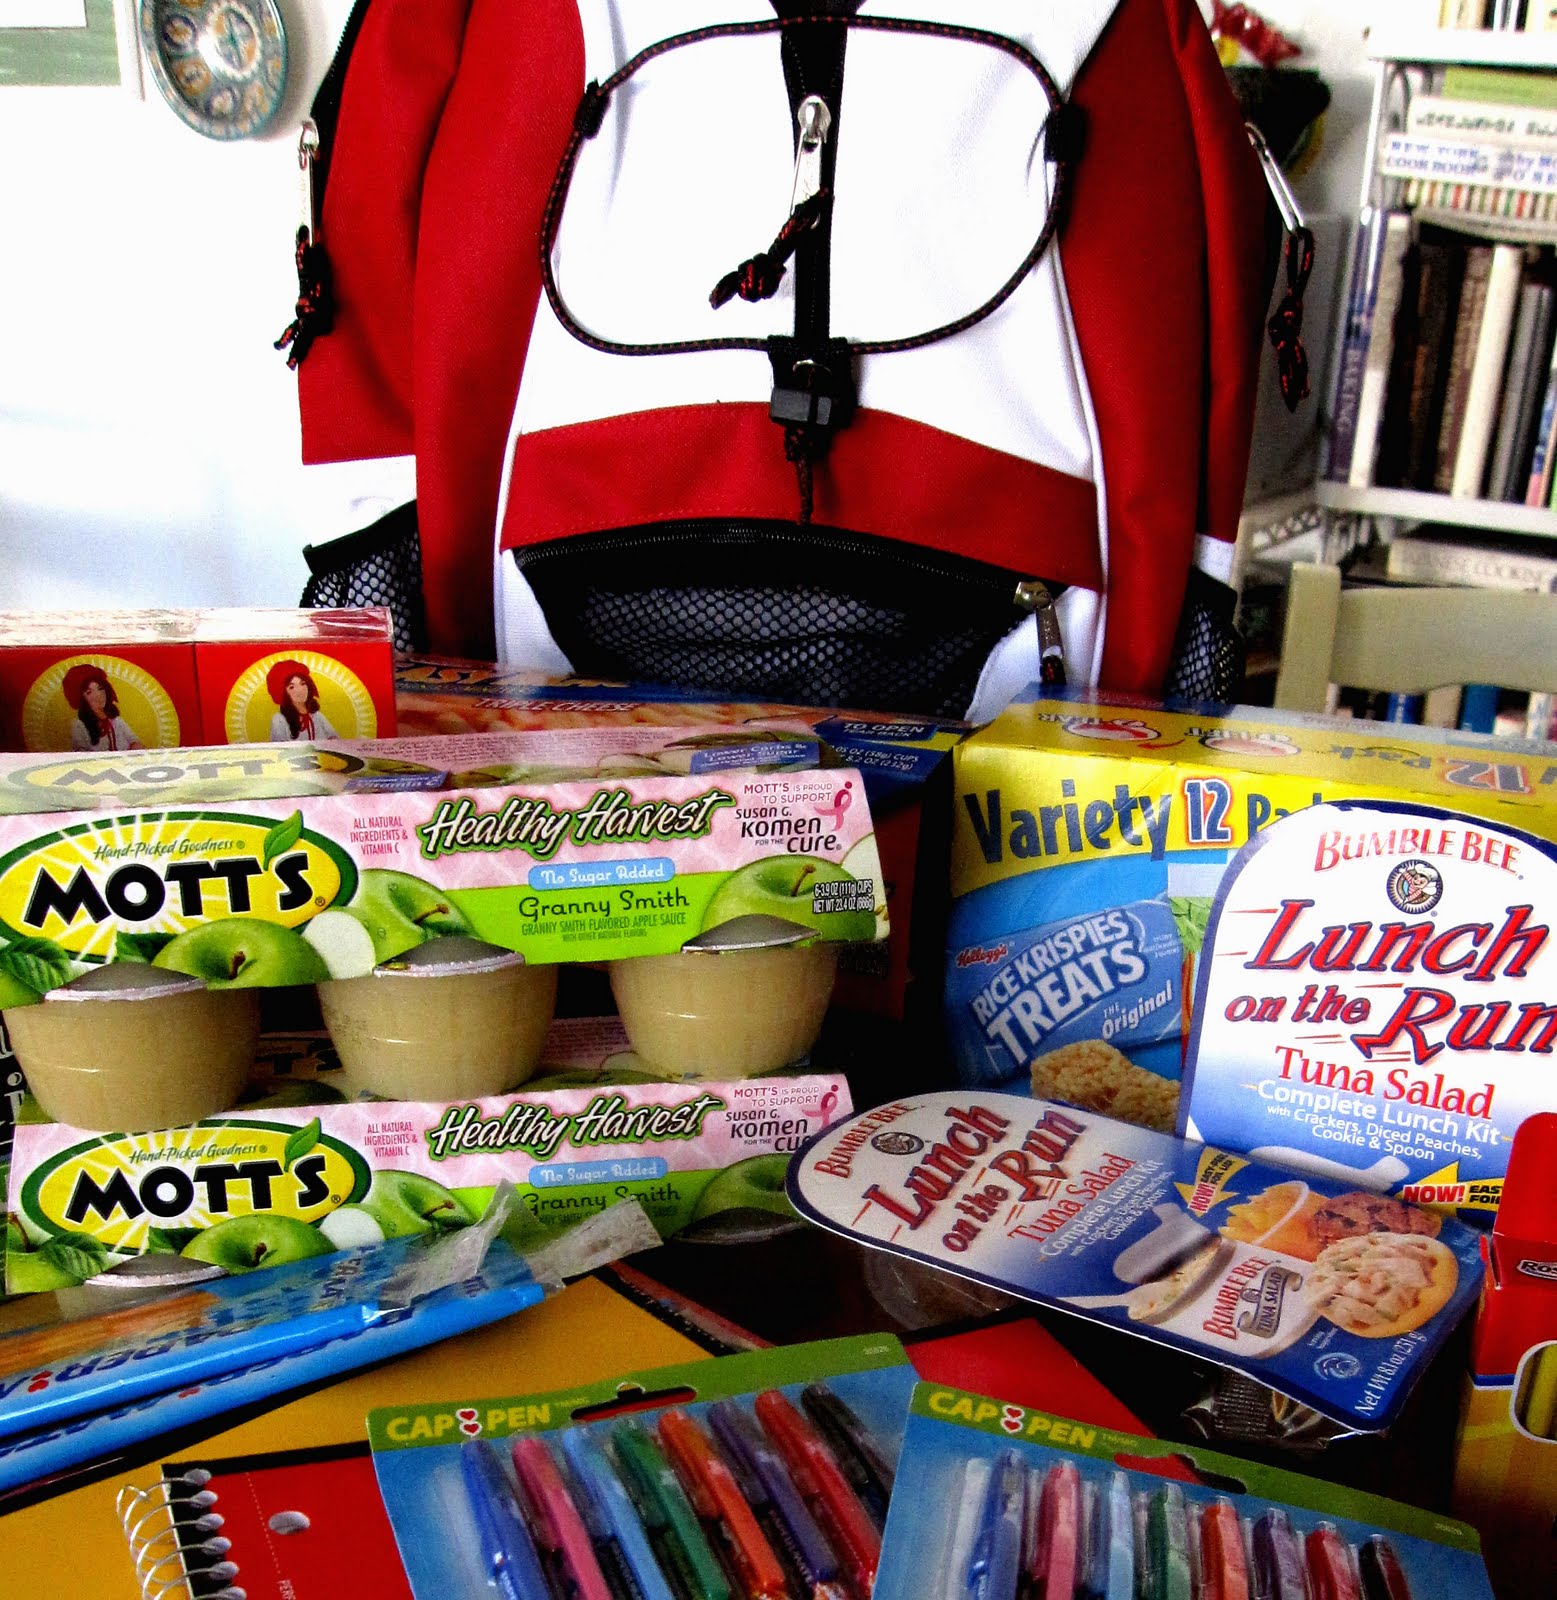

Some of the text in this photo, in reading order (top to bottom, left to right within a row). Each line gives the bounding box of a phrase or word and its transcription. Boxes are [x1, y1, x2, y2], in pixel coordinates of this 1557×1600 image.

[475, 699, 637, 712] TRIPLE CHEESE
[872, 724, 925, 733] OPEN
[864, 758, 880, 766] OZ
[893, 753, 920, 763] CUPS
[1446, 758, 1531, 793] 12
[744, 783, 832, 794] MOTT'S IS PROUD
[763, 792, 832, 804] TO SUPPORT
[353, 816, 403, 829] ALL NATURAL
[422, 790, 734, 856] Healthy Harvest
[782, 806, 792, 818] G.
[964, 779, 1171, 861] Variety
[1183, 778, 1232, 843] 12
[350, 829, 408, 843] INGREDIENTS &
[361, 842, 400, 855] VITAMIN C
[755, 838, 769, 846] FOR
[94, 838, 233, 860] Hand-Picked Goodness
[1314, 828, 1520, 876] BUMBLE BEE
[541, 863, 665, 885] No Sugar Added
[23, 853, 314, 928] MOTT'S
[830, 882, 839, 896] OZ
[857, 880, 872, 894] CUPS
[519, 887, 690, 922] Granny Smith
[813, 899, 825, 913] NET
[825, 899, 834, 911] WT
[848, 897, 856, 910] OZ
[522, 912, 686, 936] GRANNY SMITH FLAVORED APPLE SAUCE
[1243, 898, 1551, 982] Lunch
[955, 943, 1009, 967] Kellogg's
[972, 911, 1130, 1026] RICE KRISPIES
[985, 940, 1146, 1065] TREATS
[1101, 979, 1173, 1041] Original
[1103, 1001, 1120, 1020] THE
[1224, 984, 1557, 1065] on the Run
[734, 1087, 778, 1098] MOTT'S
[791, 1086, 819, 1094] PROUD
[1275, 1045, 1496, 1120] Tuna Salad
[752, 1095, 819, 1107] TO SUPPORT
[770, 1109, 780, 1118] G.
[1258, 1079, 1503, 1145] Complete Lunch Kit
[368, 1121, 413, 1133] ALL NATURAL
[430, 1096, 724, 1157] Healthy Harvest
[1267, 1104, 1483, 1160] with Crackers, Diced Peaches,
[364, 1133, 418, 1146] INGREDIENTS &
[374, 1146, 410, 1157] VITAMIN C
[814, 1103, 918, 1178] BUMBLE BEE
[1312, 1123, 1435, 1161] Cookie & Spoon
[128, 1143, 257, 1163] Hand-Picked Goodness
[540, 1162, 658, 1183] No Sugar Added
[862, 1105, 1012, 1231] Lunch
[942, 1109, 1087, 1252] on the Run
[65, 1155, 331, 1224] MOTT'S
[1007, 1152, 1137, 1244] Tuna Salad
[1189, 1183, 1216, 1212] NOW!
[1403, 1185, 1502, 1203] NOW! EAS
[1040, 1159, 1164, 1256] Complete Lunch Kit
[1103, 1188, 1168, 1240] Cookie Spoon
[1202, 1256, 1271, 1340] BUMBLE BEE
[1257, 1272, 1282, 1333] TUNA SALAD
[1390, 1353, 1406, 1365] oz
[1367, 1371, 1392, 1392] Wt
[1354, 1390, 1381, 1416] Net
[386, 1404, 550, 1441] CAP PEN
[927, 1391, 998, 1423] CAP
[1026, 1416, 1096, 1449] PEN
